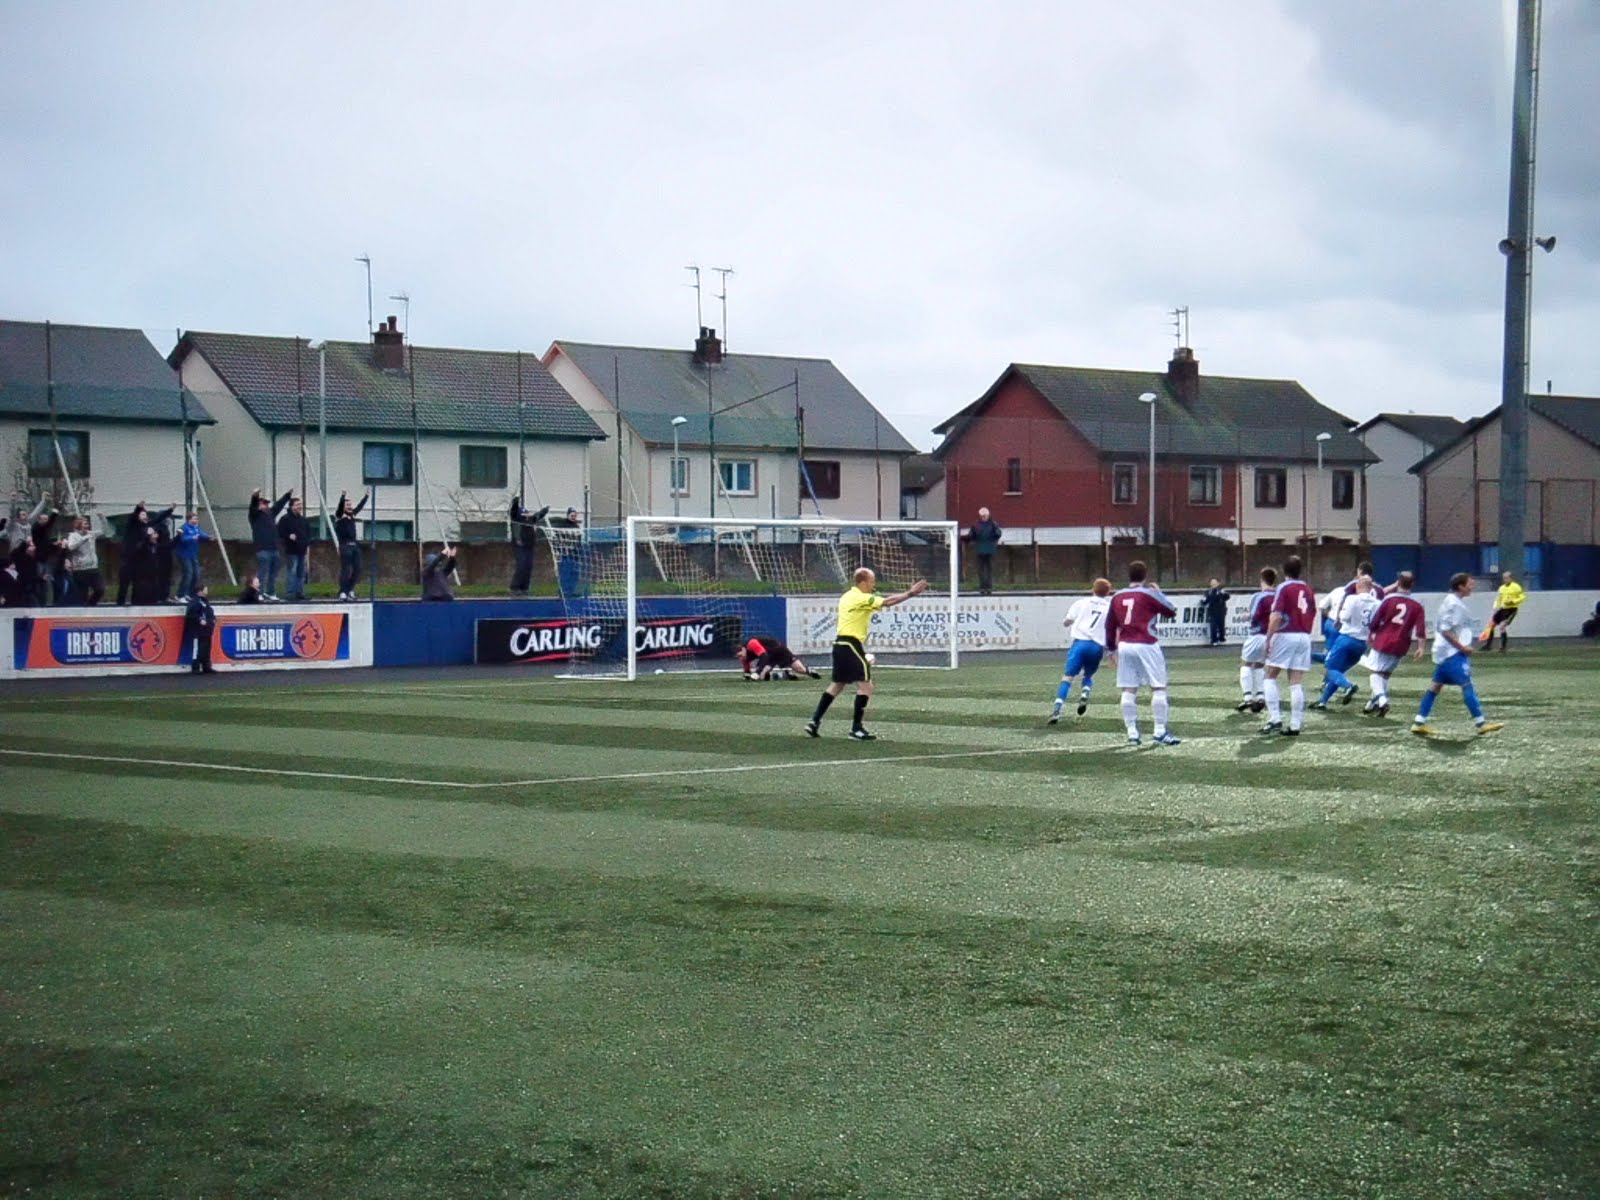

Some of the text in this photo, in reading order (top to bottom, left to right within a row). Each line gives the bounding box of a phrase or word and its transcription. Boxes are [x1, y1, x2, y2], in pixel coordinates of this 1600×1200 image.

[1122, 598, 1135, 625] 7
[1298, 590, 1308, 614] 4
[871, 613, 882, 625] &
[894, 613, 902, 624] L
[1090, 610, 1102, 628] 7
[1183, 607, 1209, 623] DIR
[1362, 609, 1372, 627] 3
[1391, 603, 1407, 624] 2
[510, 625, 601, 656] CARLING
[635, 624, 713, 652] CARLING
[1157, 626, 1209, 638] NSTRUCTION
